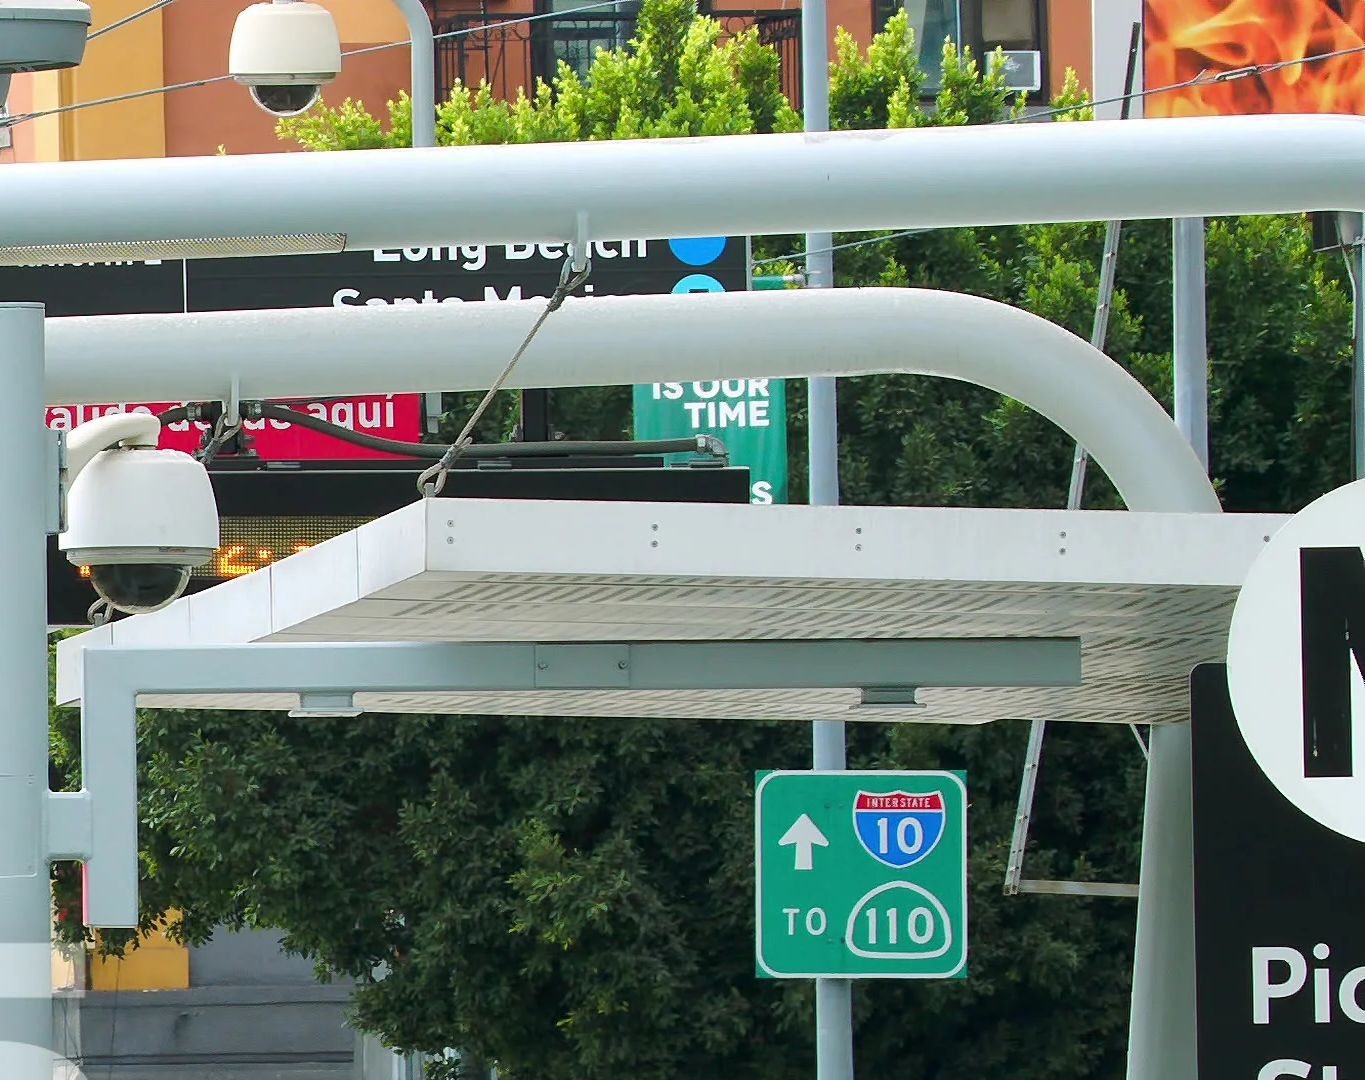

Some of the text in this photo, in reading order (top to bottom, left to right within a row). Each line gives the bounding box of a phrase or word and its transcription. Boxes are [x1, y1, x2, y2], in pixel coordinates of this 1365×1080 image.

[652, 378, 769, 399] IS OUR
[684, 400, 769, 428] TIME
[866, 797, 931, 808] INTERSTATE
[877, 816, 923, 855] 10
[782, 906, 935, 944] TO 110
